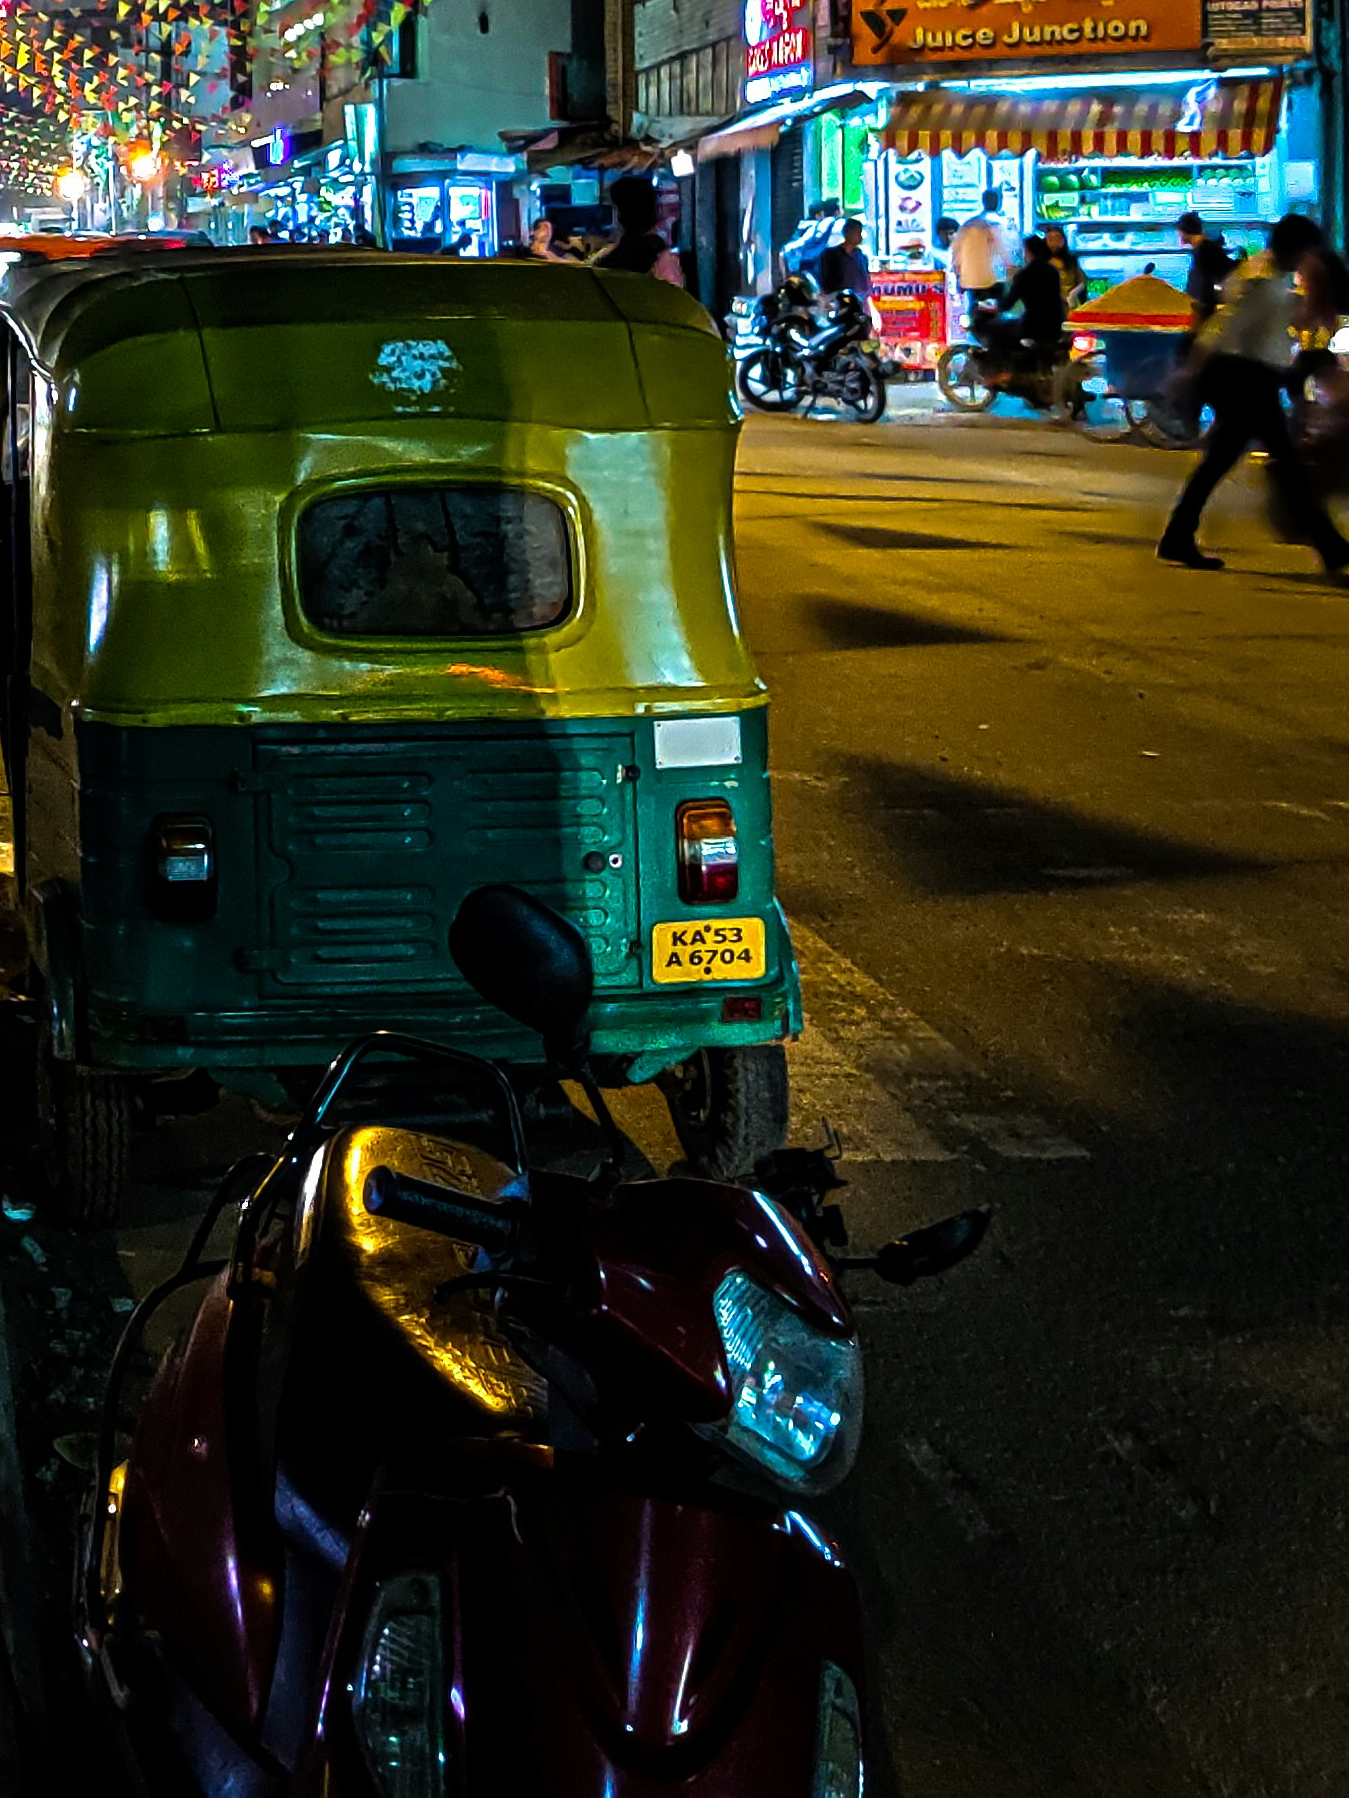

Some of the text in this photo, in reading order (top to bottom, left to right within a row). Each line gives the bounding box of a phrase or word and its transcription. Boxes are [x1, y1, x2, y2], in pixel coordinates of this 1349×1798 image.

[908, 17, 1149, 49] Juice Junction
[671, 927, 743, 947] KA 53
[664, 948, 753, 968] A 6704
